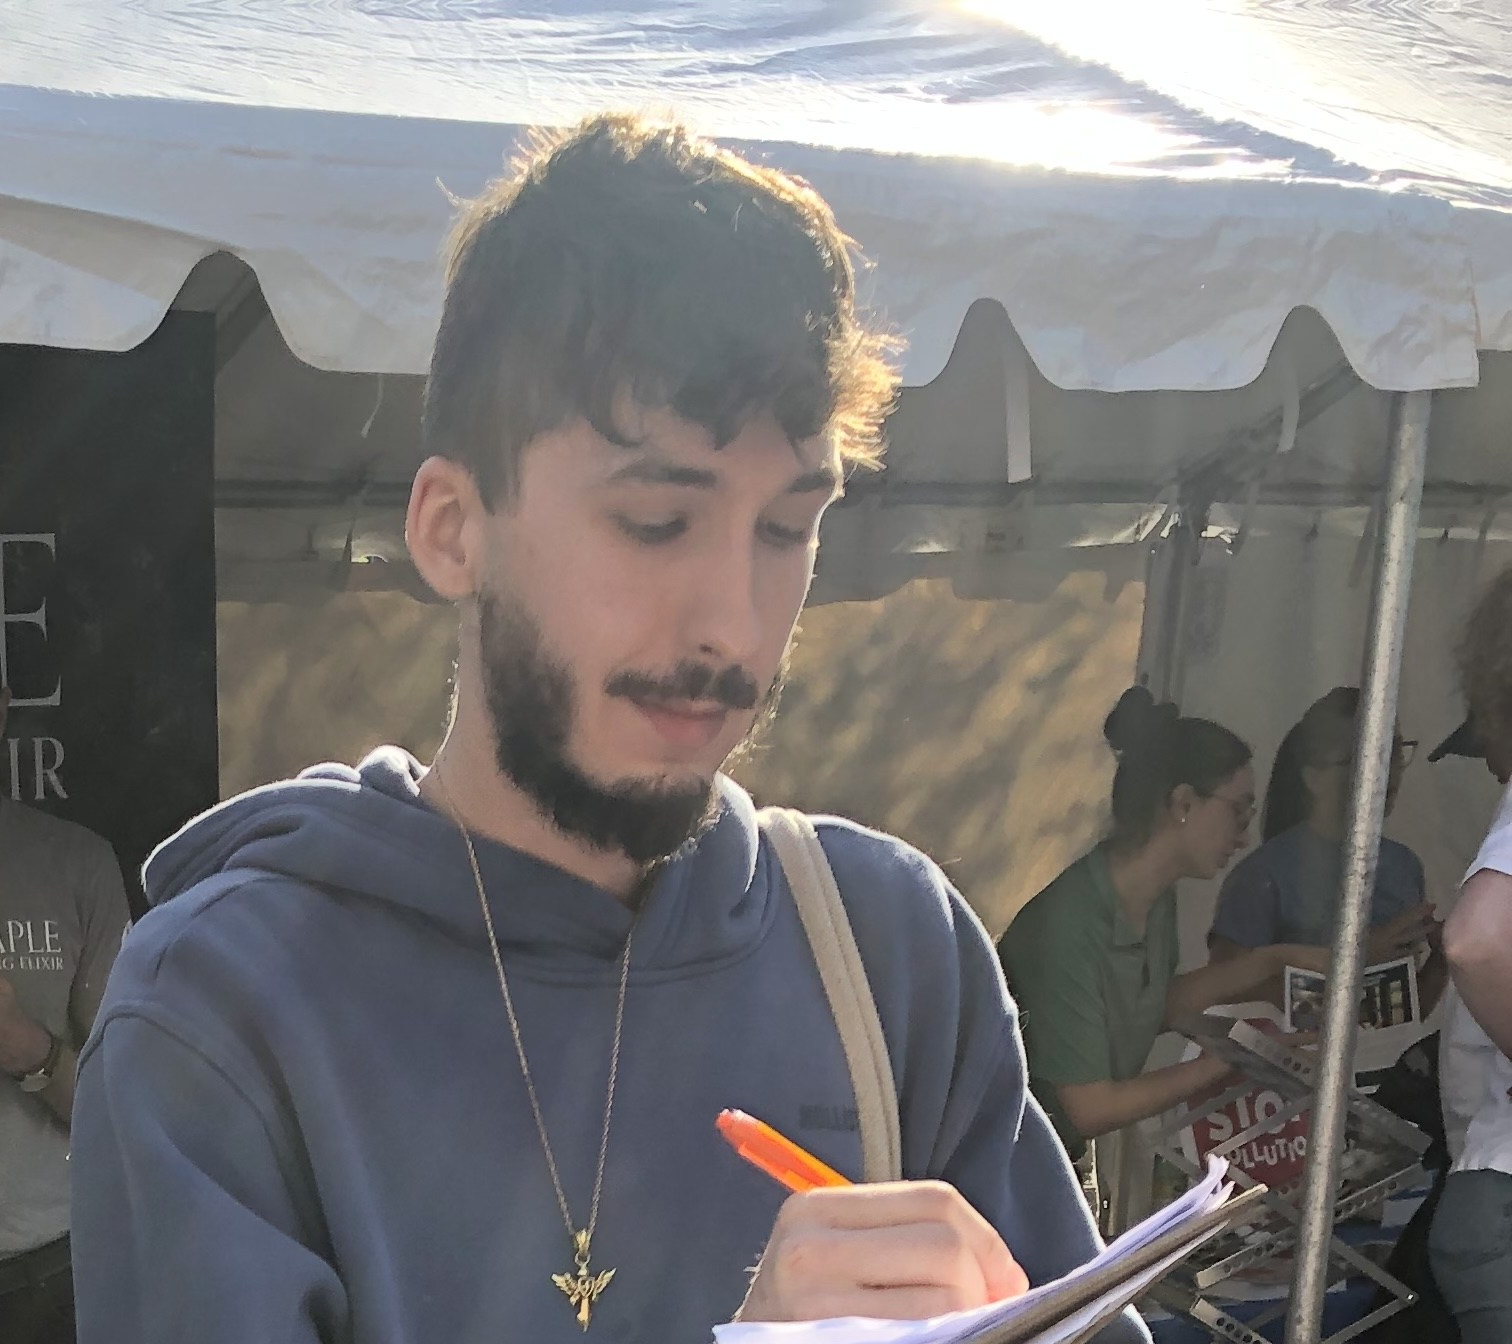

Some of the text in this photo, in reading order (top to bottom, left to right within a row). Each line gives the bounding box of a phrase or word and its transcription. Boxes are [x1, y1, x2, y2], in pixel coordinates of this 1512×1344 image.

[20, 956, 64, 971] ELIXIR
[1206, 1090, 1300, 1141] STO
[1226, 1135, 1307, 1168] OLLUTIO
